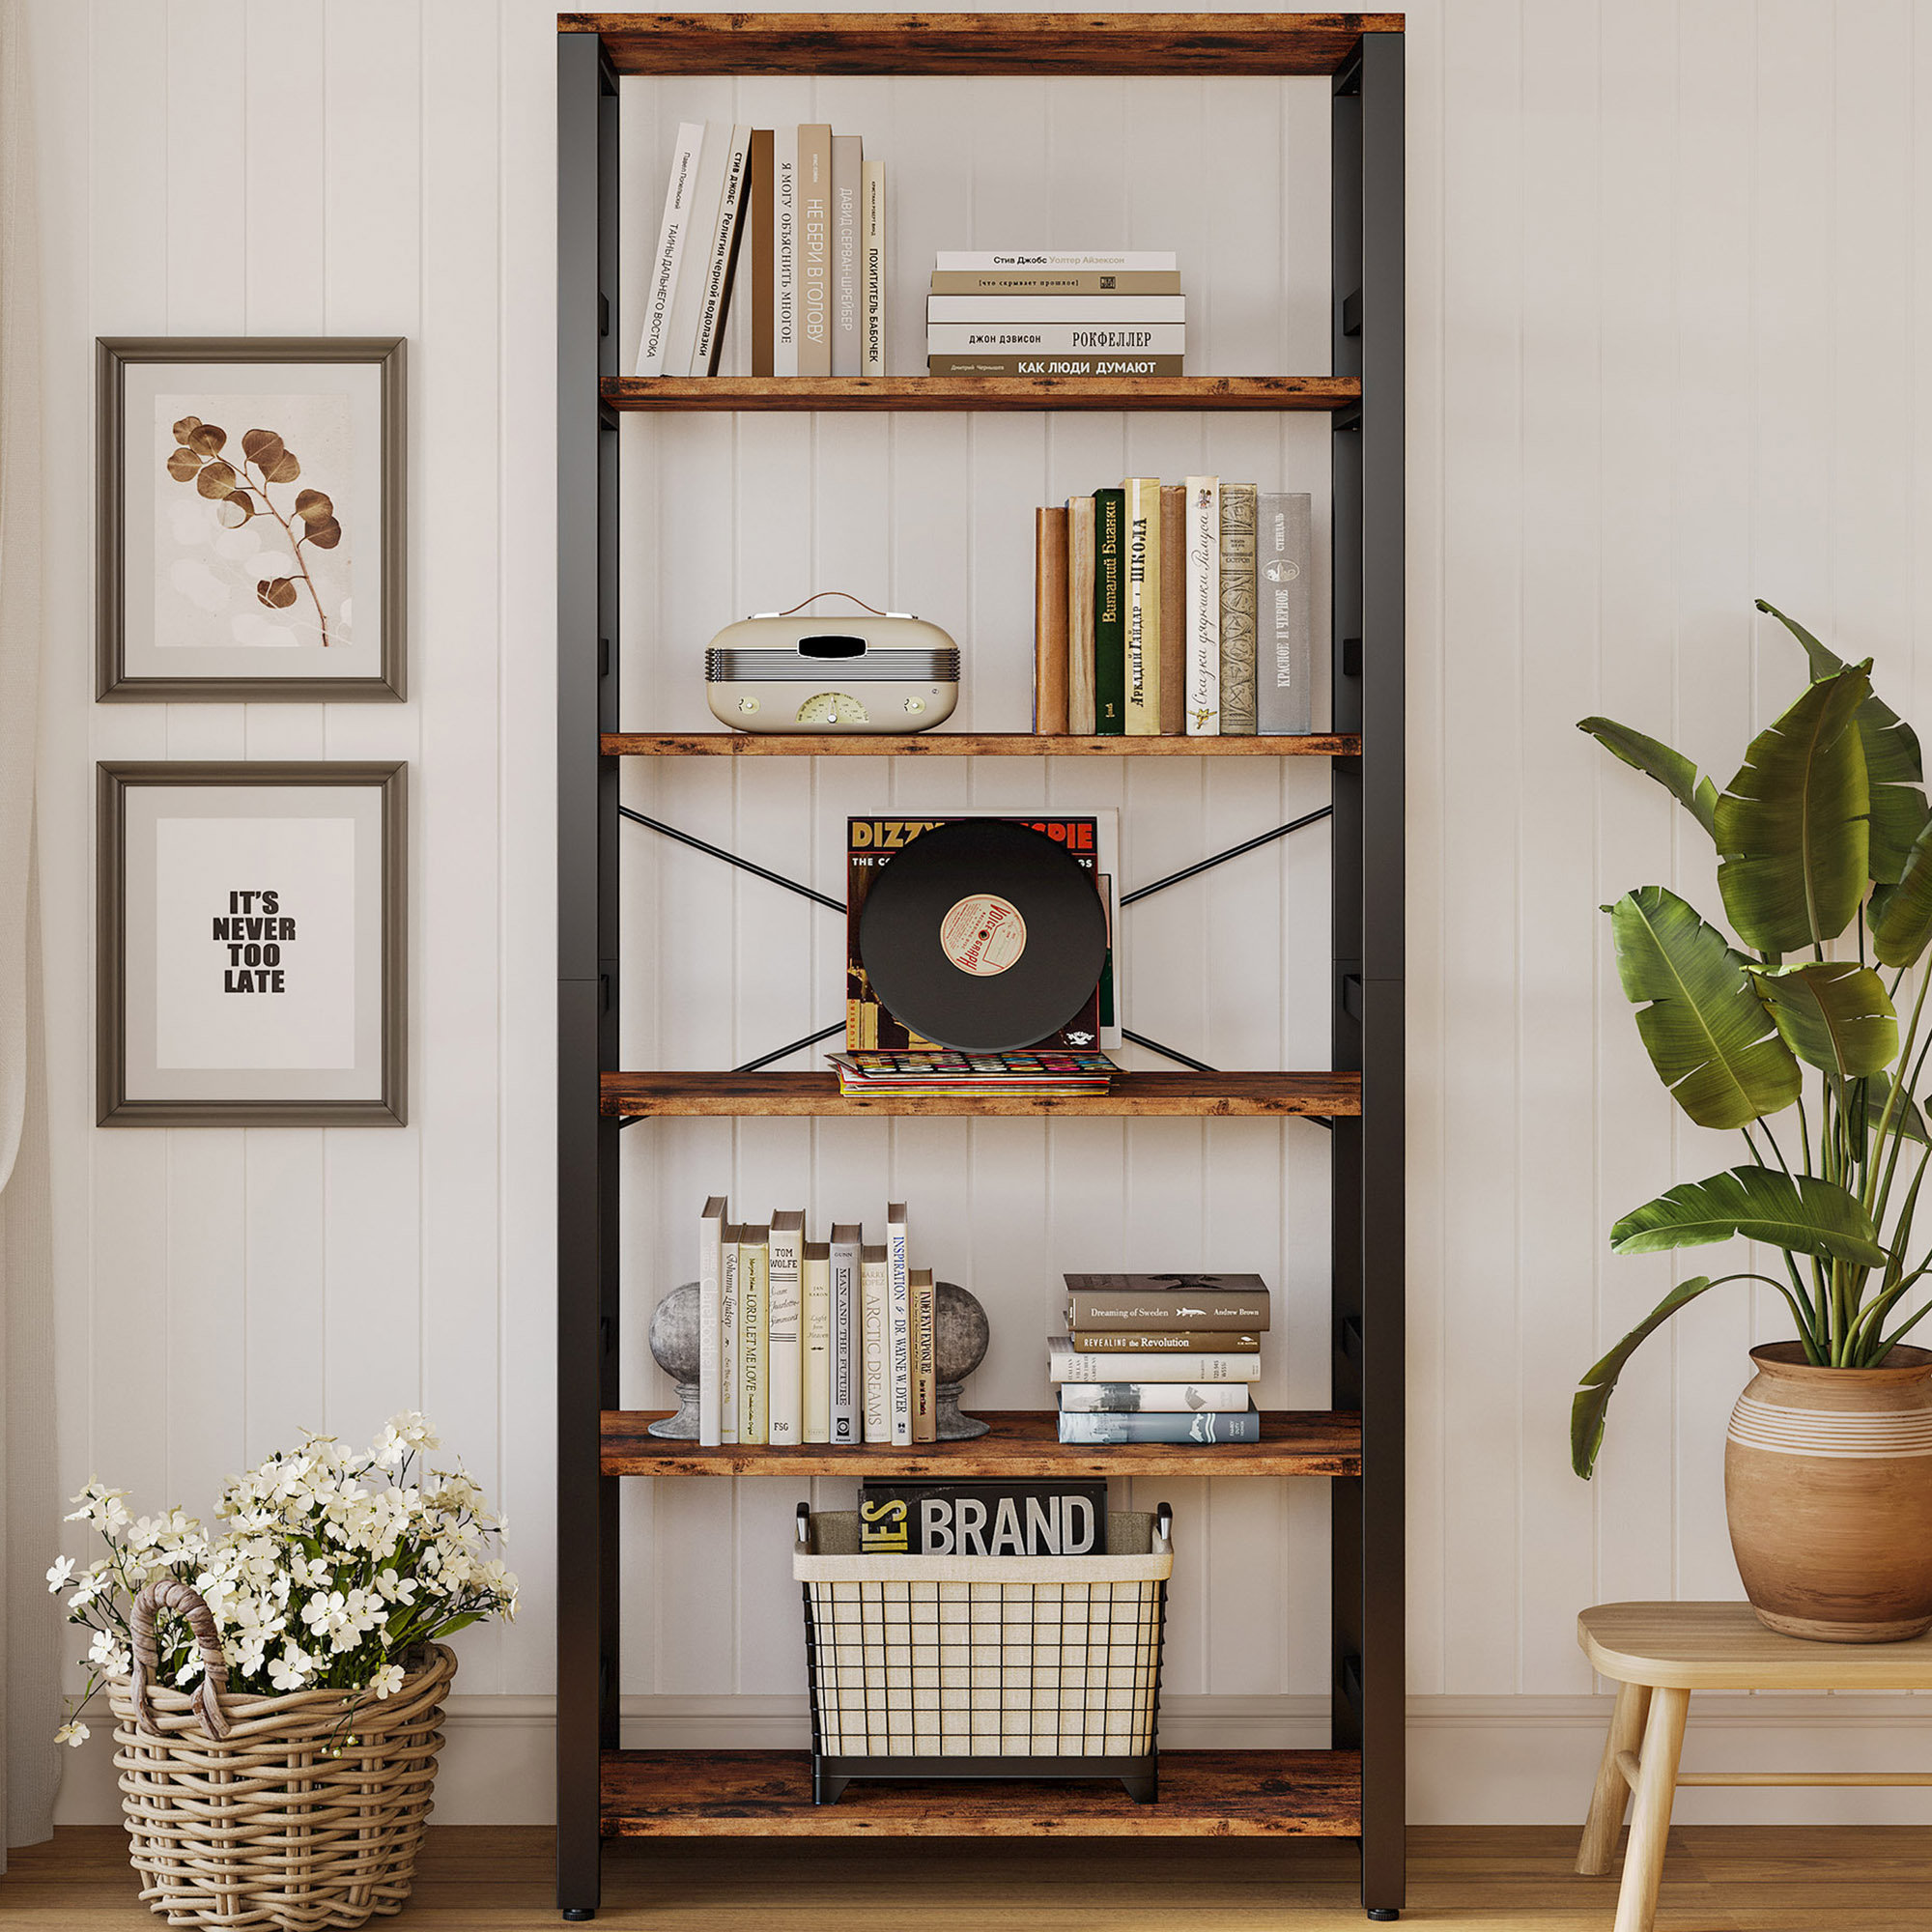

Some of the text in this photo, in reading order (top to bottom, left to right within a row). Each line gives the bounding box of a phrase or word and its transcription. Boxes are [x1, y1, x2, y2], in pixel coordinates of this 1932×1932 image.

[781, 175, 791, 209] МОГУ
[781, 213, 791, 287] ОБЪЯСНИТЬ
[839, 187, 854, 330] ДАВИД СЕРВАН-ШРЕЙБЕР
[993, 256, 1015, 265] Стив
[1017, 256, 1047, 266] Джобс
[1083, 256, 1125, 265] Айзексон
[655, 259, 672, 310] ДАЛЬНЕГО
[699, 213, 733, 355] Религия черной водолазки
[808, 199, 823, 344] НЕ БЕРИ В ГОЛОВУ
[781, 292, 791, 343] МНОГОЕ
[869, 248, 878, 362] ПОХИТИТЕЛЬ БАБОЧЕК
[647, 312, 663, 357] ВОСТОКА
[969, 332, 1151, 347] ДЖОН ДЭВИСОН РОКФЕЛЛЕР
[1018, 362, 1045, 373] КАК
[1048, 362, 1090, 375] ЛЮДИ
[1096, 362, 1156, 375] ДУМАЮТ
[1275, 513, 1285, 552] СТЕНДАЛЬ
[1102, 500, 1117, 623] Виталий Бианки
[1130, 518, 1147, 583] ШКОЛА
[1191, 513, 1216, 705] Сказки дядюшки Римуса
[1276, 589, 1289, 629] ЧЕРНОЕ
[1277, 643, 1290, 688] КРАСНОЕ
[852, 822, 945, 848] DIZZ
[852, 858, 873, 867] THE
[230, 891, 279, 915] IT'S
[985, 904, 1010, 931] VOICE
[213, 918, 296, 940] NEVER
[227, 944, 280, 967] TOO
[956, 940, 982, 971] GRAPH
[225, 970, 285, 993] LATE
[770, 1260, 798, 1268] WOLFE
[775, 1248, 793, 1258] TOM
[894, 1236, 905, 1300] INSPIRATION
[722, 1254, 737, 1328] Johanna Lindsey
[745, 1294, 757, 1324] LORD,
[866, 1294, 881, 1354] ARCTIC
[1091, 1308, 1128, 1318] Dreaming
[1129, 1308, 1139, 1317] of
[1139, 1308, 1169, 1317] Sweden
[746, 1326, 757, 1346] LET
[895, 1320, 906, 1336] DR.
[920, 1292, 931, 1375] INDECENT EXPOSURE
[1141, 1338, 1189, 1347] Revolution
[746, 1347, 757, 1364] ME
[895, 1338, 906, 1372] WAYNE
[746, 1365, 757, 1392] LOVE
[867, 1360, 882, 1426] DREAMS
[896, 1374, 906, 1385] W.
[896, 1387, 907, 1413] DYER
[774, 1423, 789, 1432] FSG
[921, 1496, 1094, 1555] BRAND
